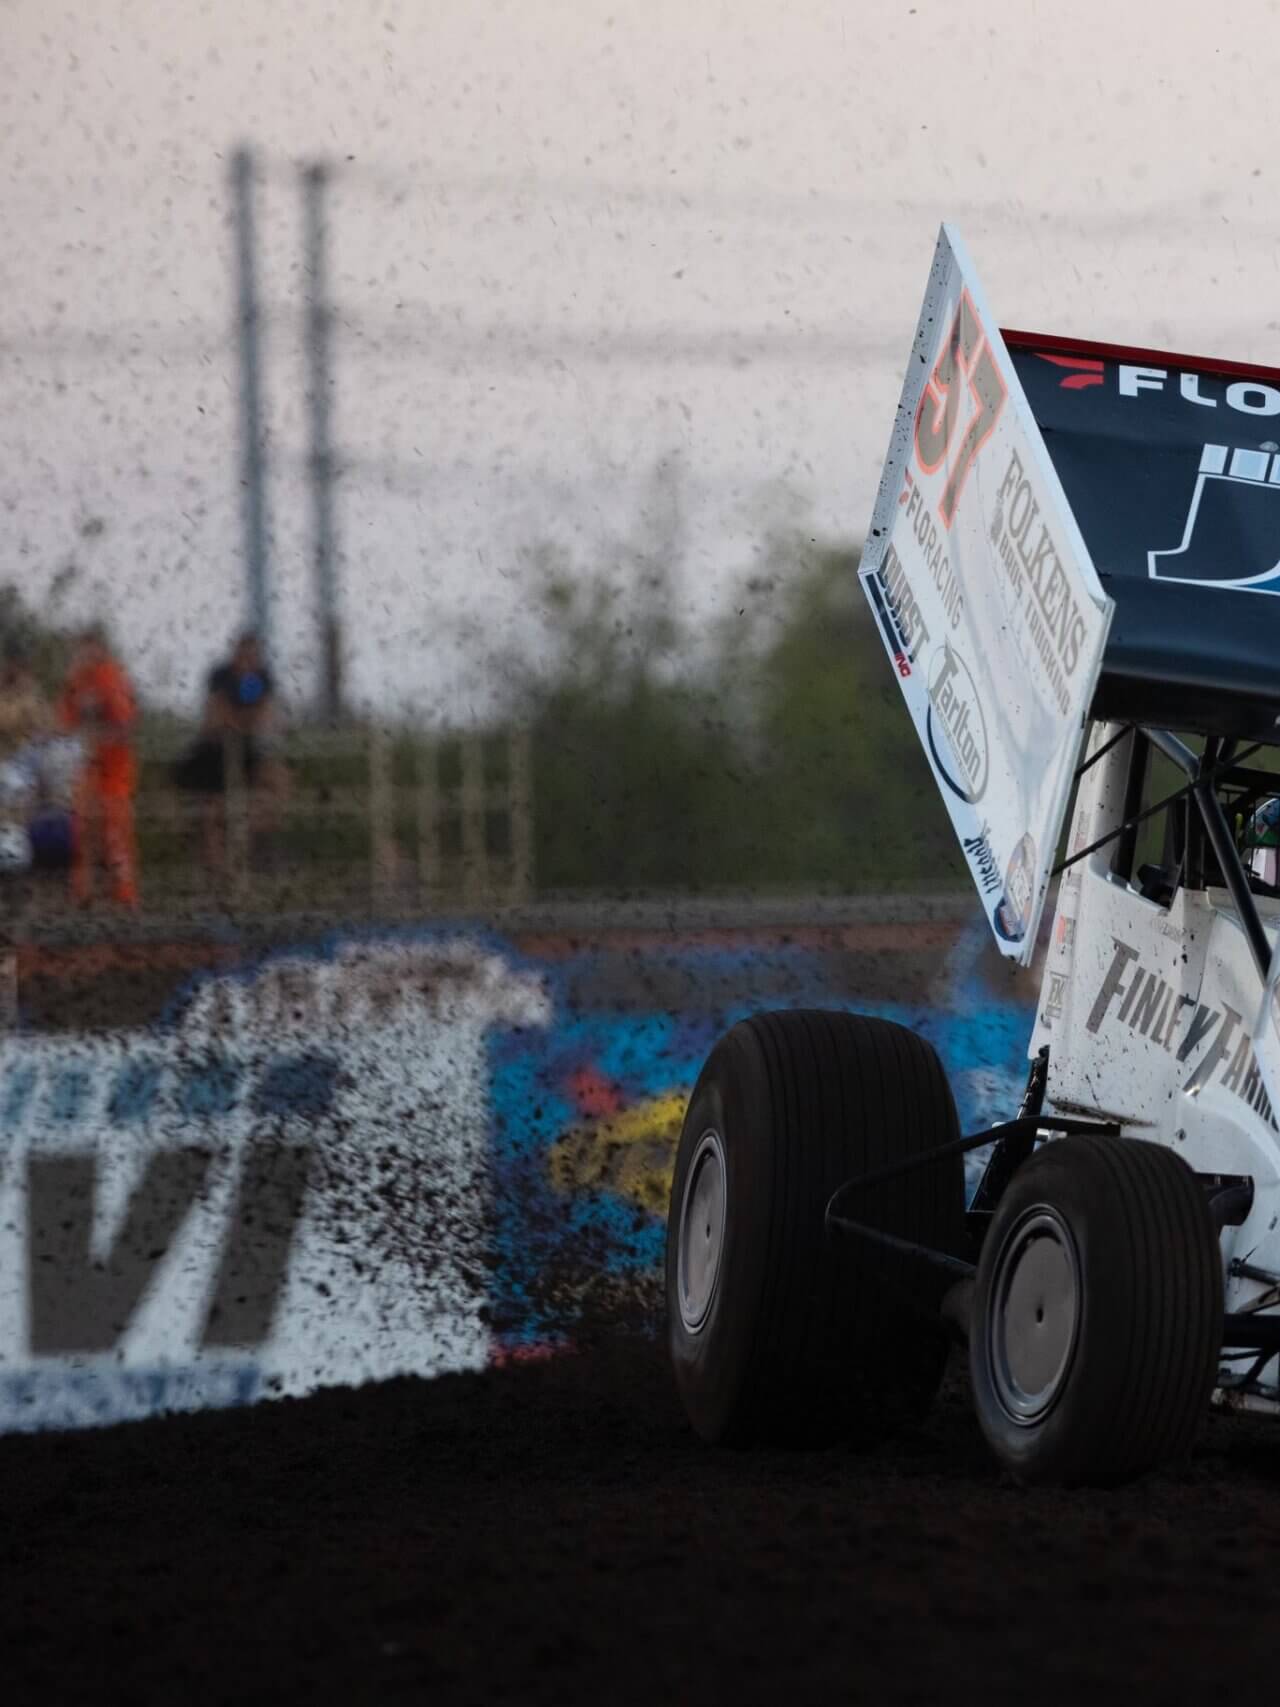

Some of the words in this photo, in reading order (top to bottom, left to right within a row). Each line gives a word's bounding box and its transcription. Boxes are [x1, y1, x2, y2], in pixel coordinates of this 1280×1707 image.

[905, 485, 964, 631] FLORACING
[999, 447, 1088, 677] FOLKENS
[929, 633, 982, 785] Tarlton
[1085, 934, 1221, 1064] FINLEY
[1182, 1000, 1280, 1134] FARM
